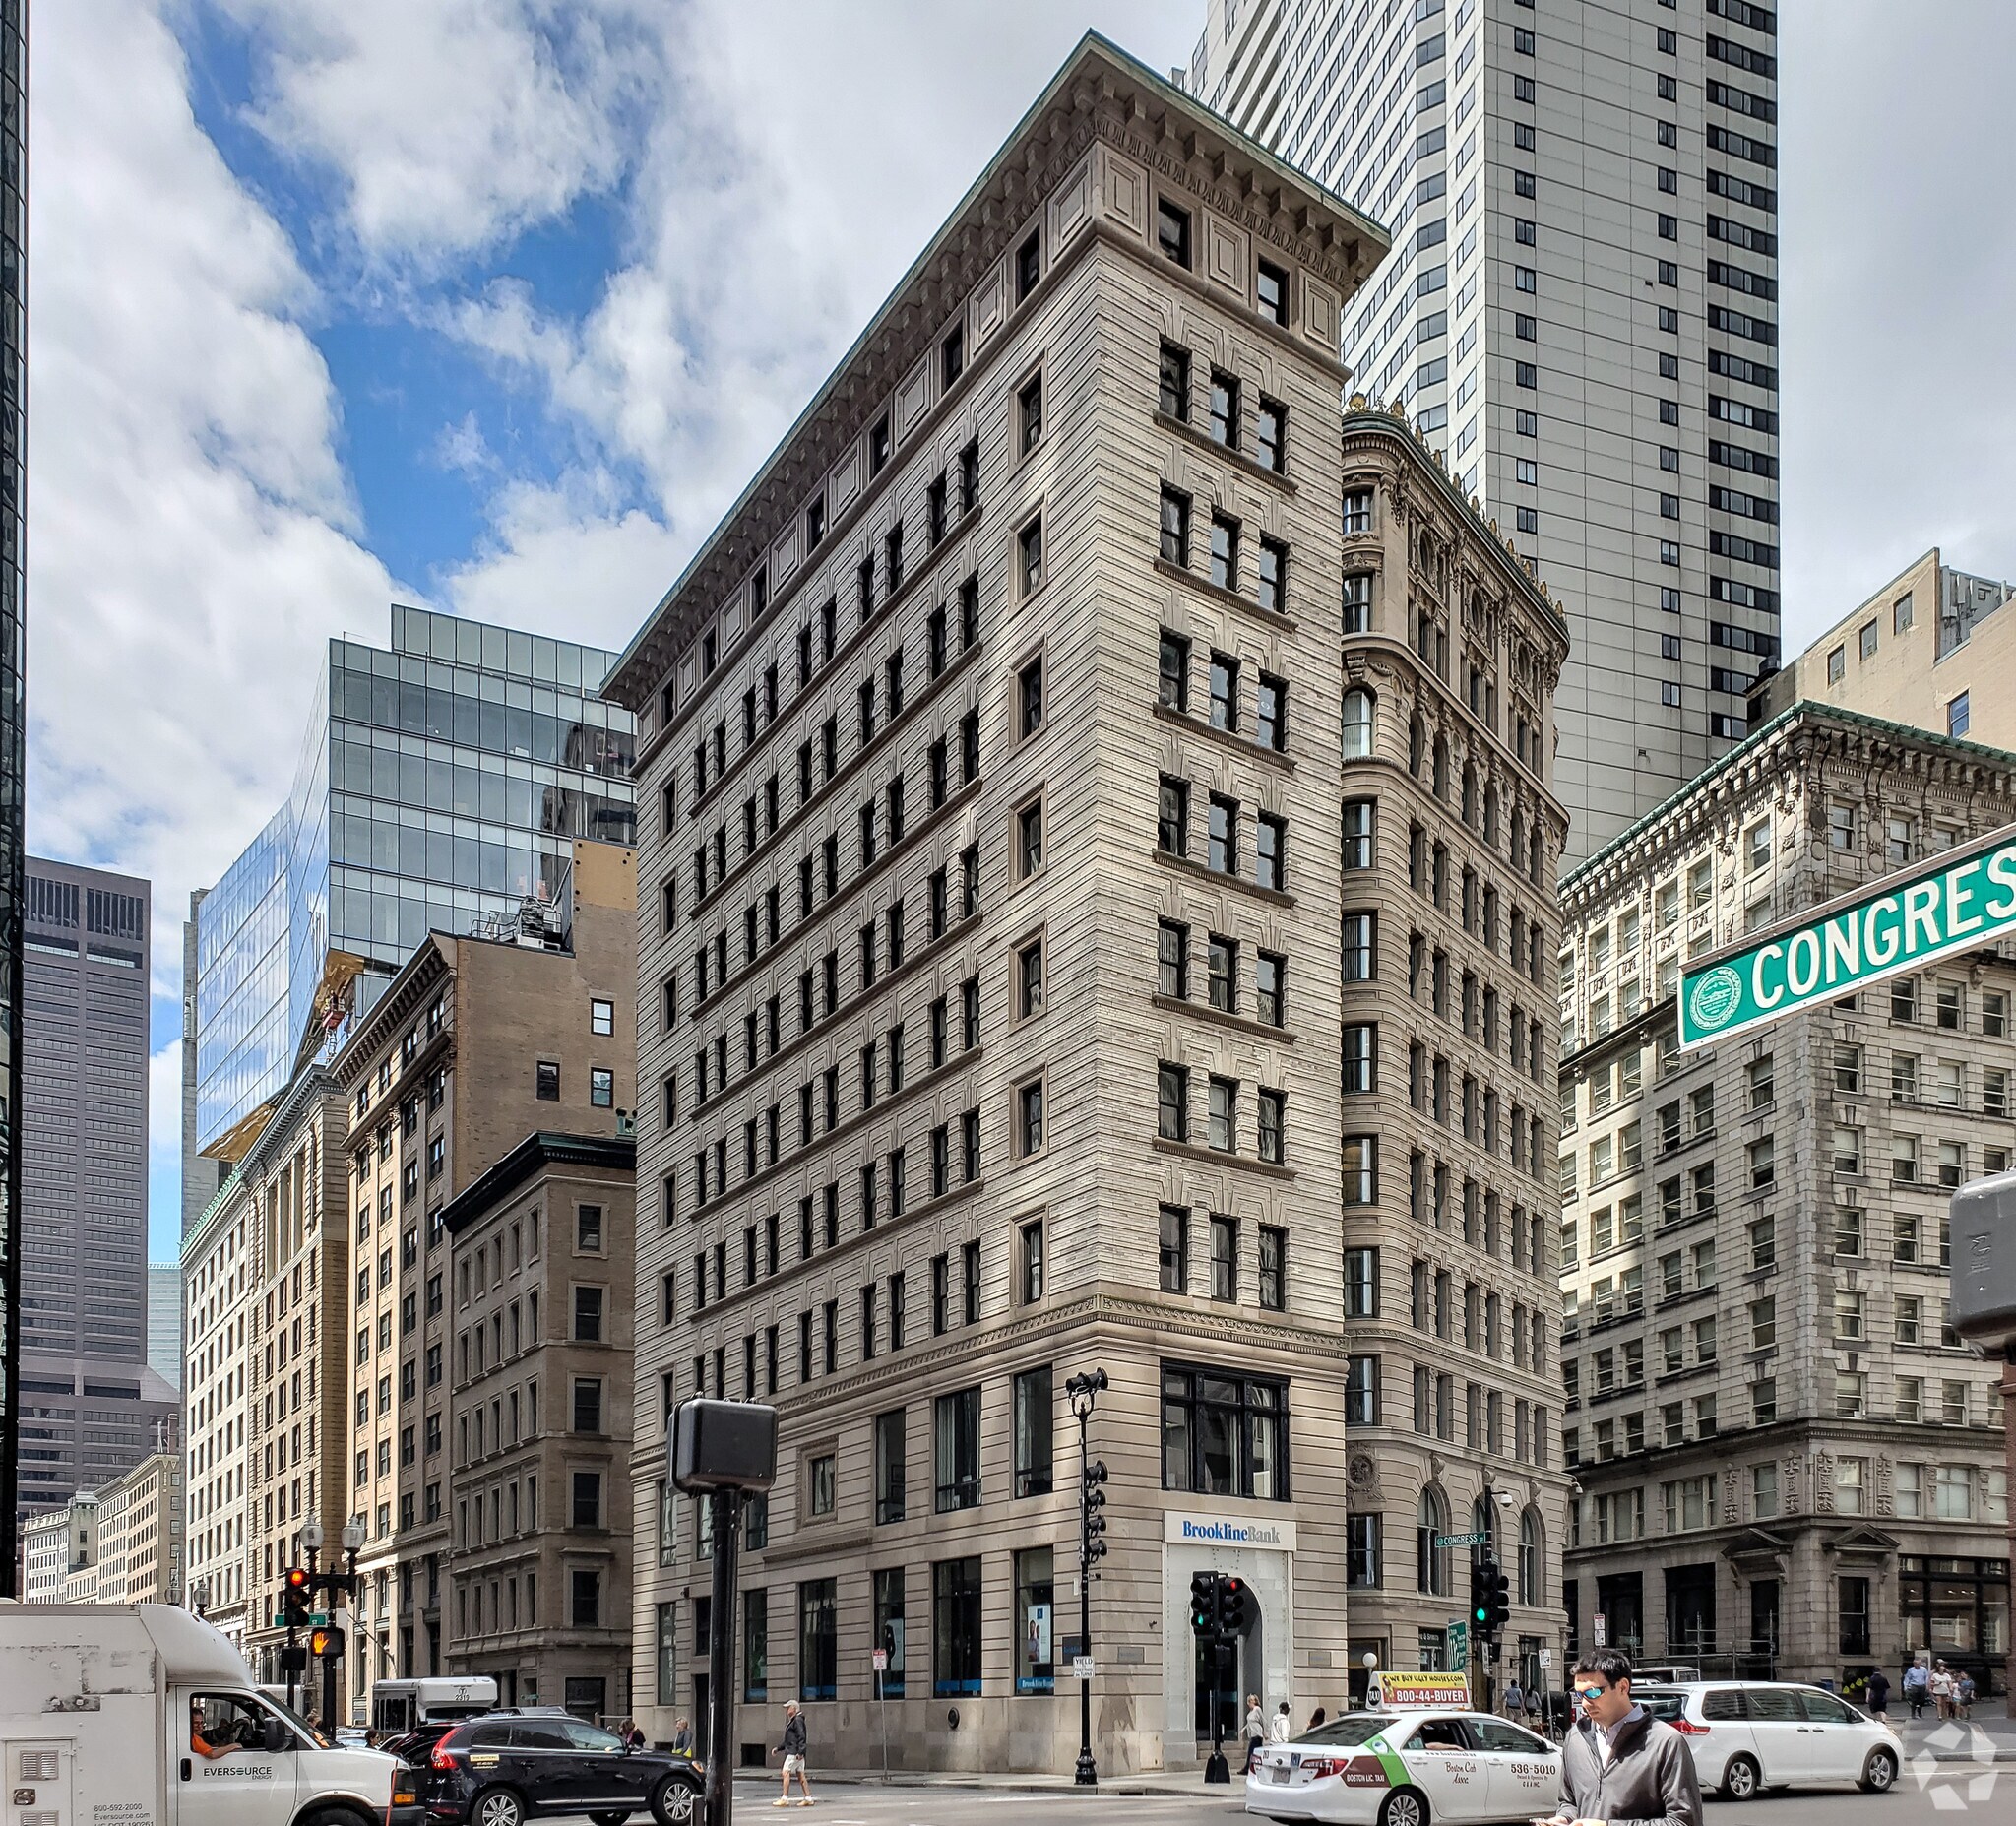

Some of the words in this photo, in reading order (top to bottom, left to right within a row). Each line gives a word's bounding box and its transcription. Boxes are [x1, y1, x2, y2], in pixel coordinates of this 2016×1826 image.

[1752, 846, 2016, 1009] CONGRES
[1443, 1534, 1478, 1545] CONGRESS
[1397, 1690, 1465, 1702] 800-44-BUYER
[204, 1766, 272, 1777] EVERSOURCE
[1510, 1763, 1556, 1775] 536-5010
[94, 1803, 143, 1812] 800-592-2000
